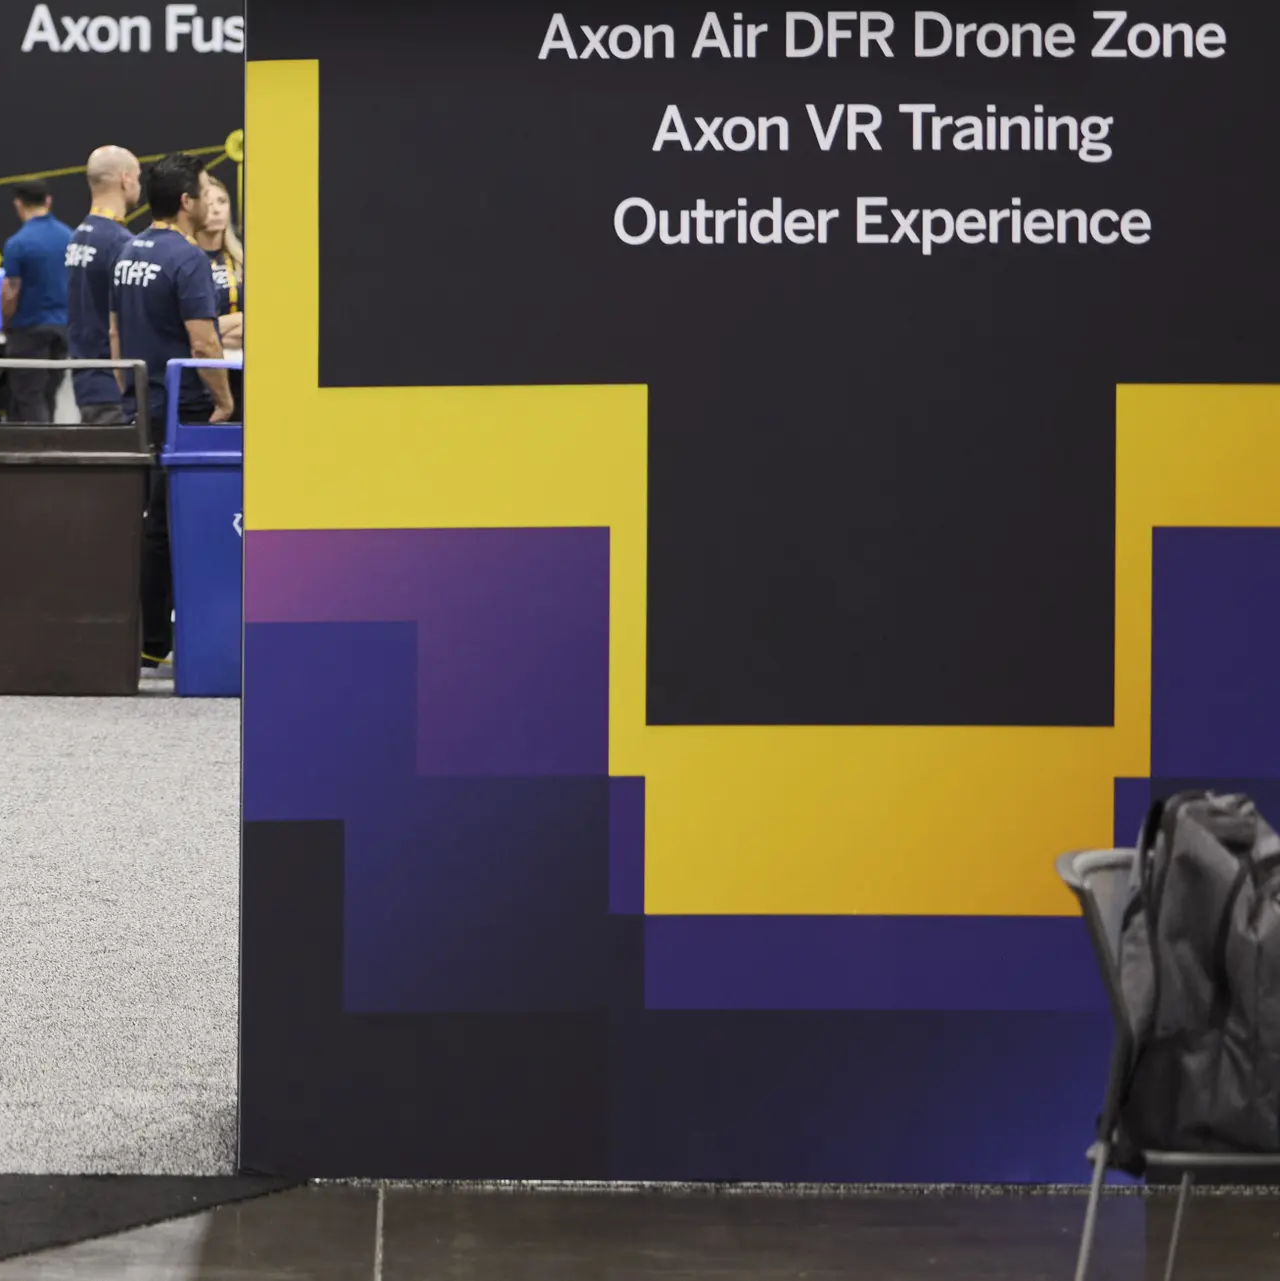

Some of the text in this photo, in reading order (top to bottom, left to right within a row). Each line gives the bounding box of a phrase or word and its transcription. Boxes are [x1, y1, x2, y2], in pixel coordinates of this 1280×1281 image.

[21, 4, 244, 53] Axon Fus
[538, 10, 1227, 60] Axon Air DFR Drone Zone
[652, 104, 1114, 163] Axon VR Training
[613, 197, 1152, 256] Outrider Experience
